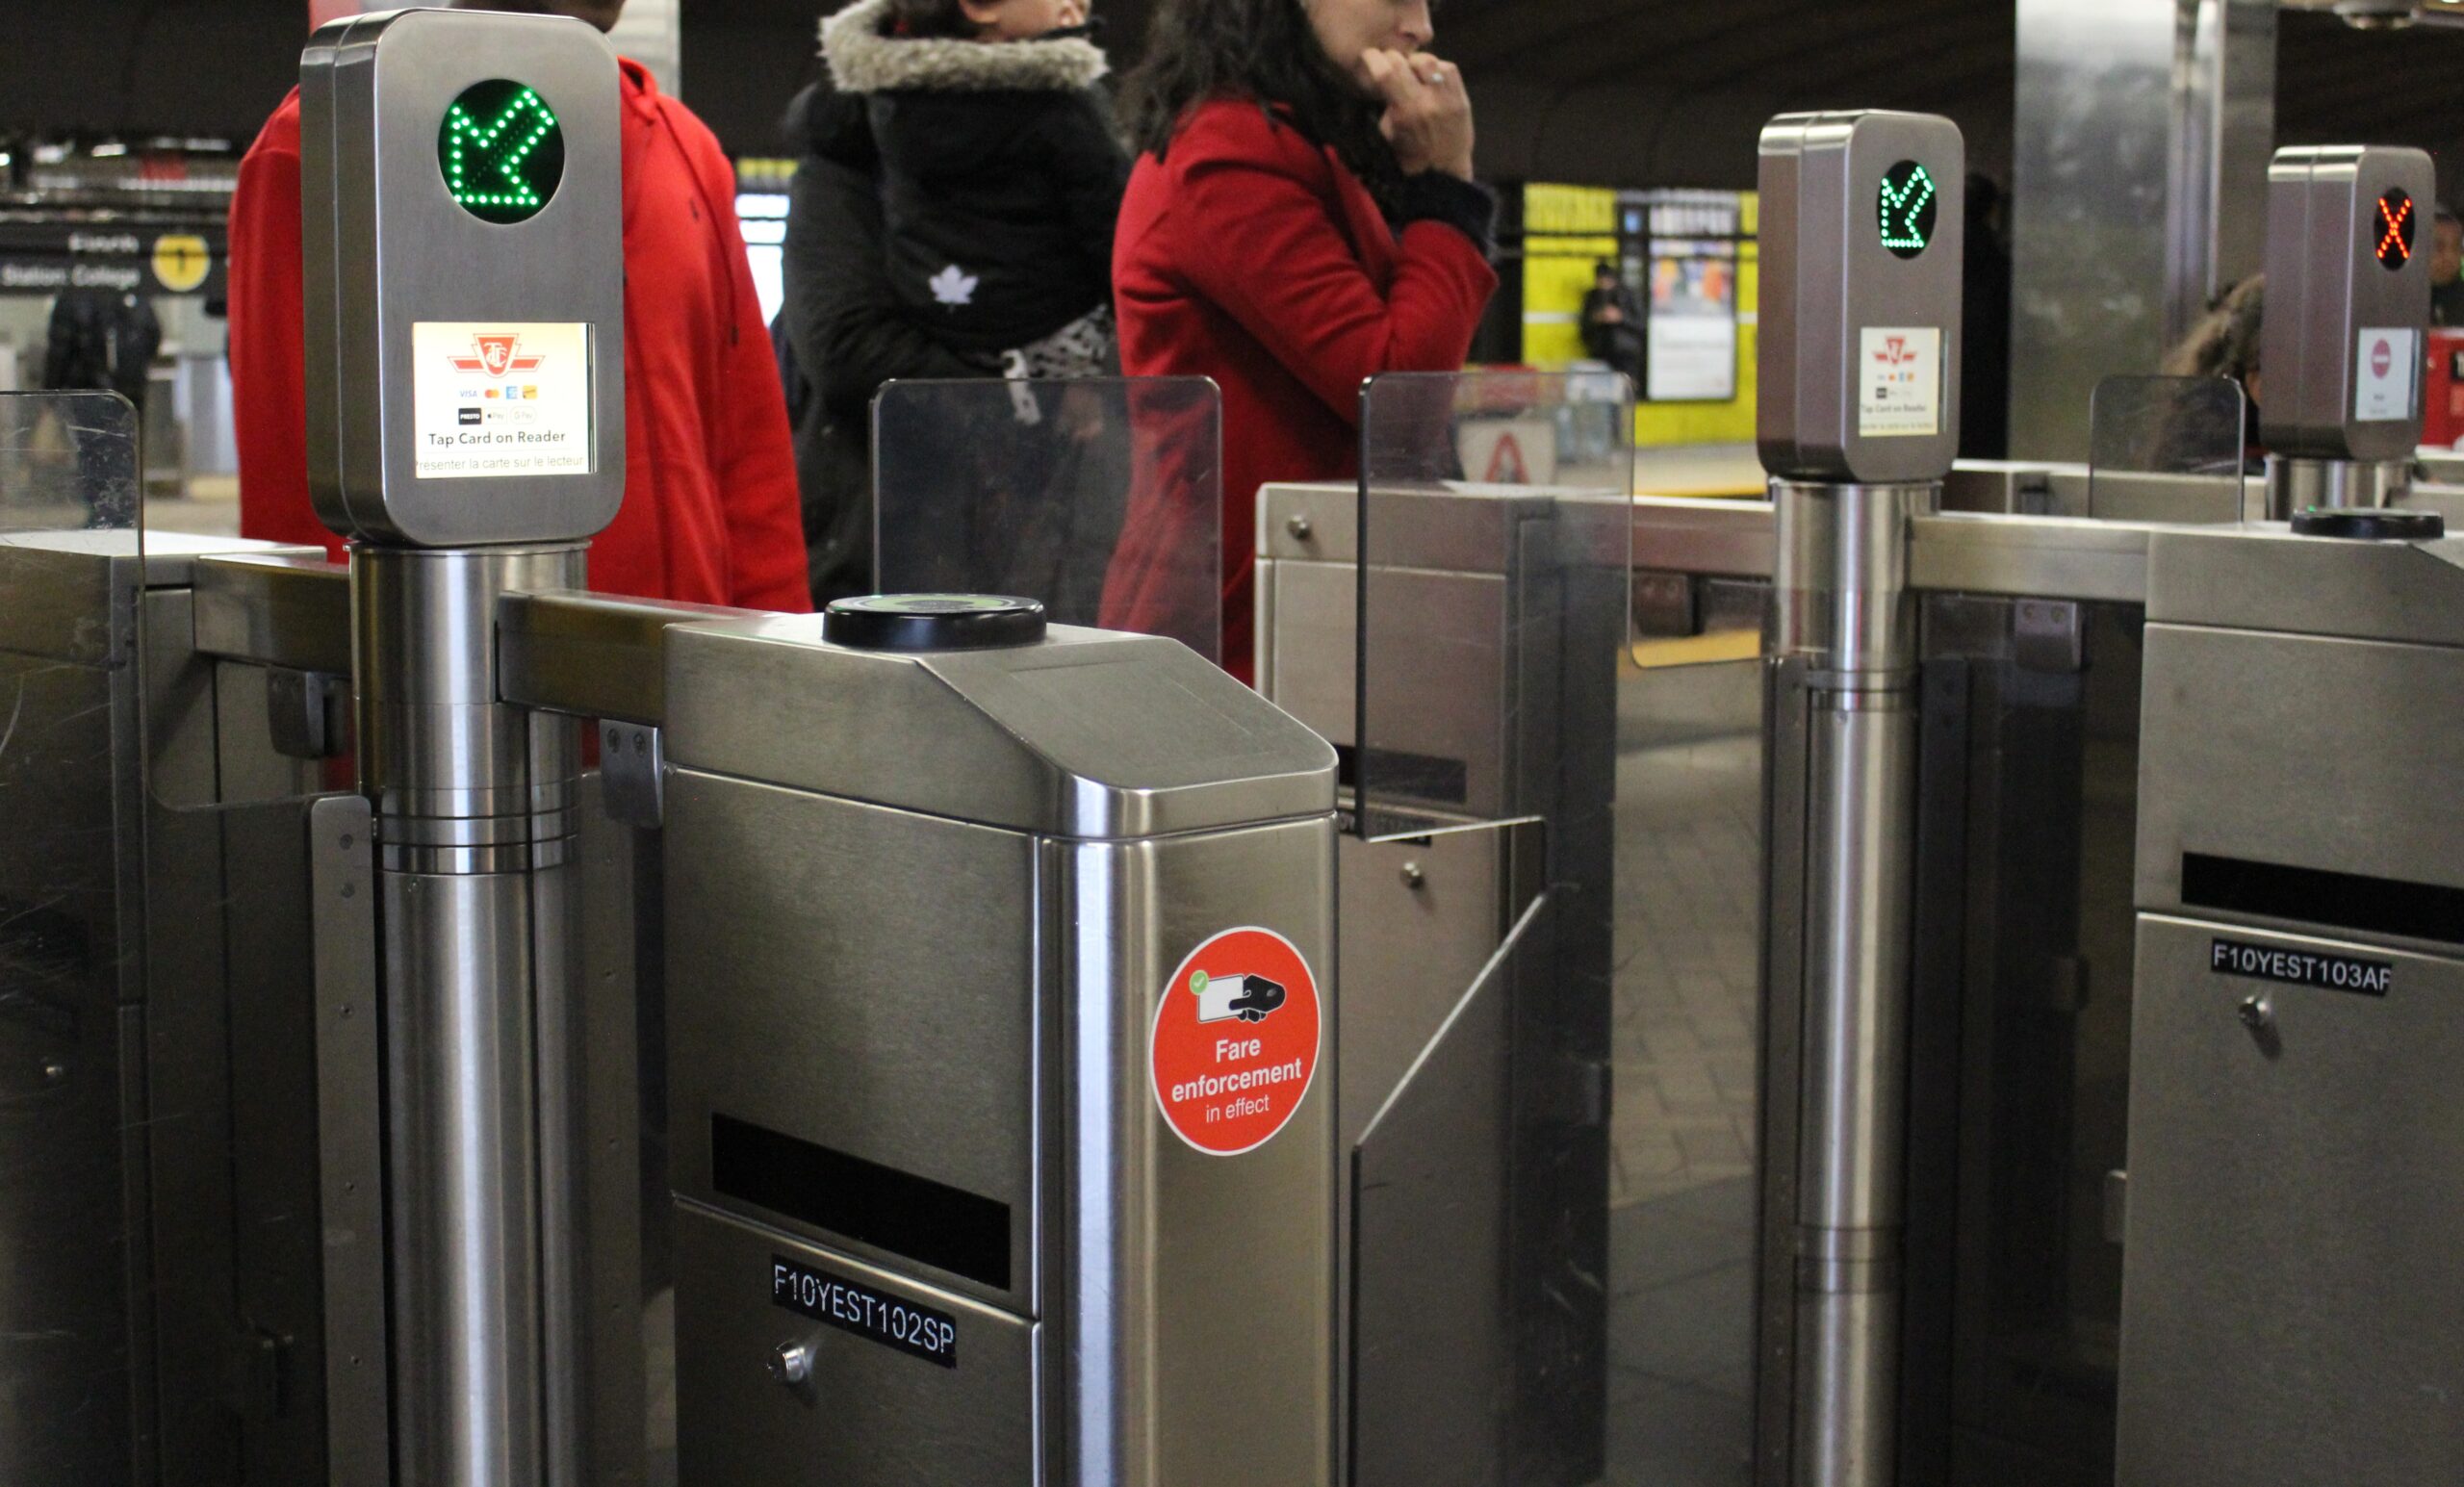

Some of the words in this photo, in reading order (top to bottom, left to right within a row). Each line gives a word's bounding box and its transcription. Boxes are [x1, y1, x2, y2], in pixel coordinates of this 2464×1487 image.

[459, 390, 478, 398] VISA
[428, 433, 454, 448] Tap
[458, 431, 491, 445] Card
[496, 433, 514, 444] on
[518, 430, 565, 443] Reader
[469, 458, 480, 470] la
[482, 456, 510, 469] carte
[514, 456, 530, 468] sur
[534, 454, 544, 466] le
[547, 454, 583, 466] lecteur
[1216, 1038, 1261, 1063] Fare
[1171, 1058, 1302, 1103] enforcement
[1206, 1105, 1220, 1123] in
[1225, 1094, 1270, 1119] effect
[774, 1264, 954, 1354] F10YEST102SP
